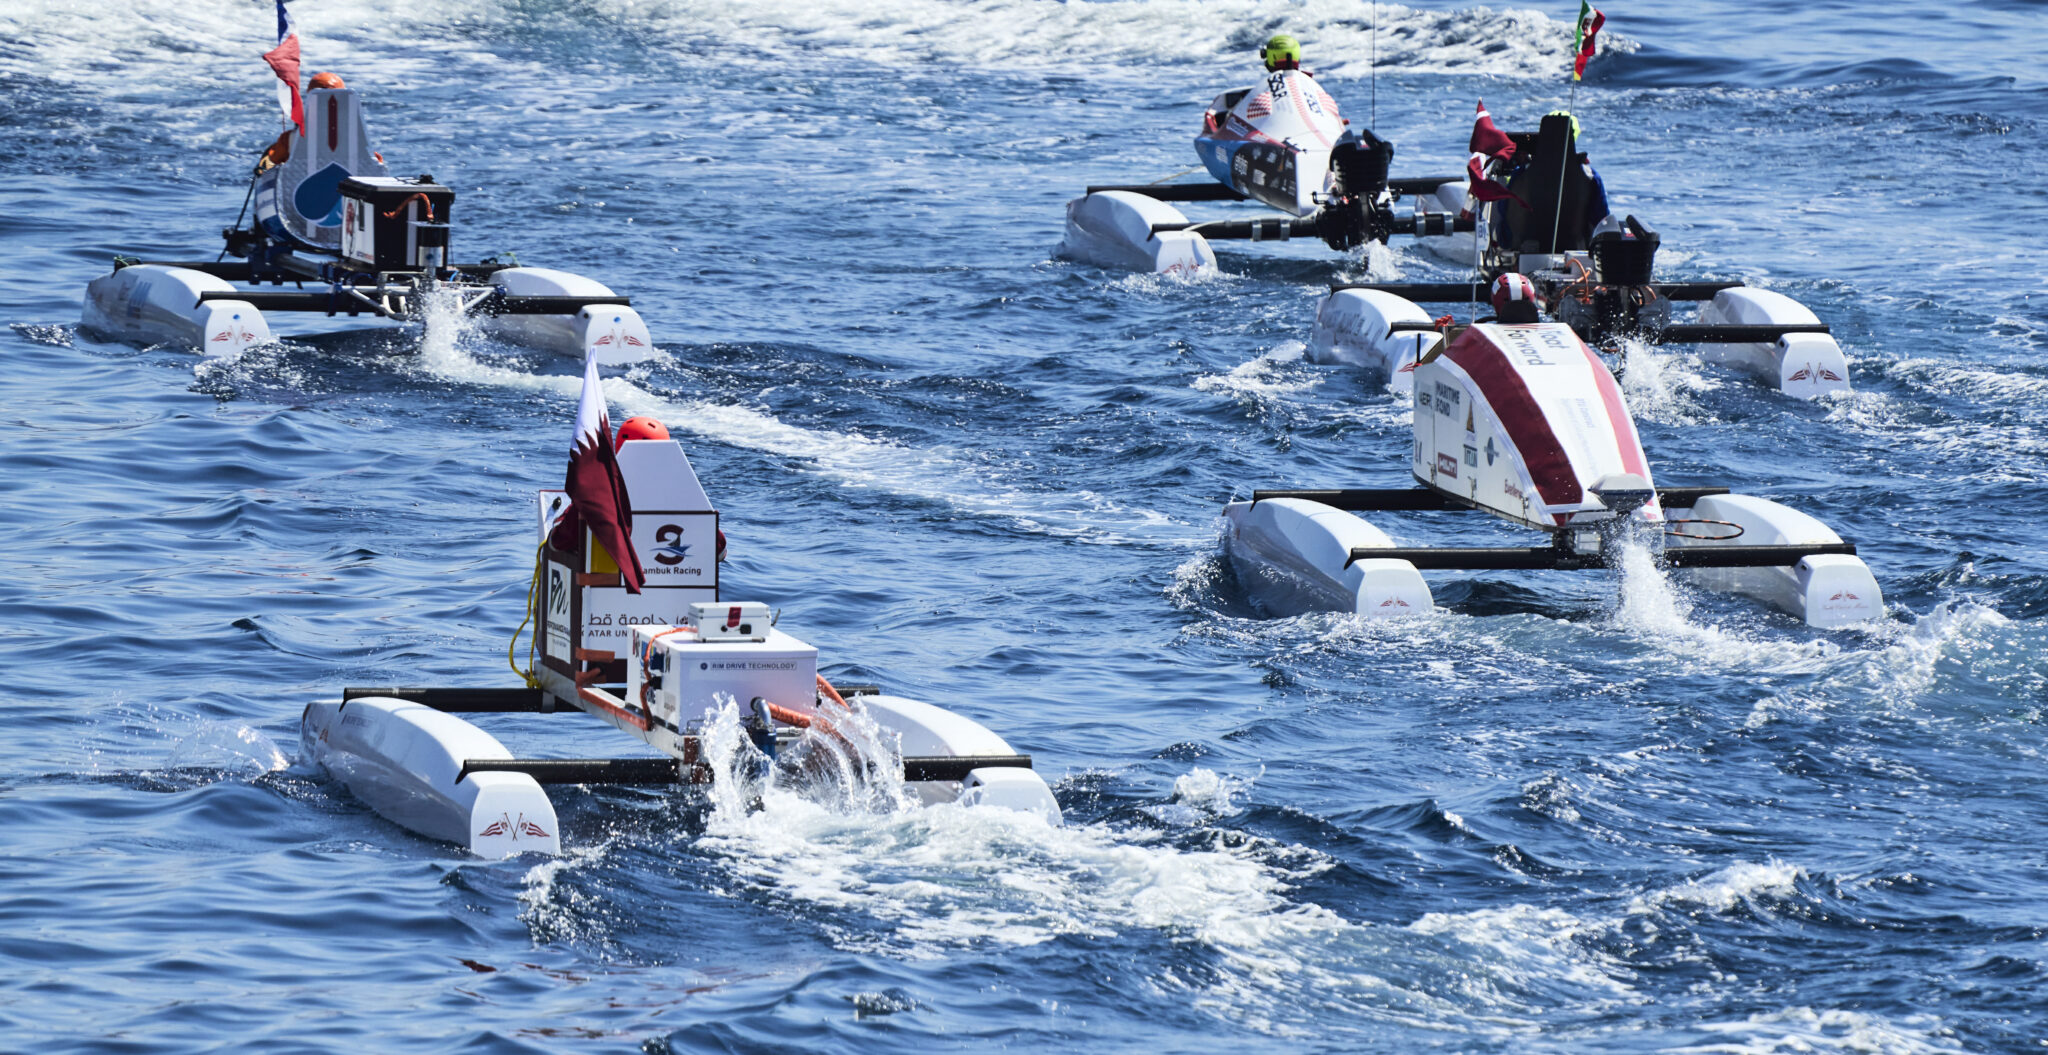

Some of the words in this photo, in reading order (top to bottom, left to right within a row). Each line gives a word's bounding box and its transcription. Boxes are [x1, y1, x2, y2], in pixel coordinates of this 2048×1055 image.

[1504, 329, 1557, 366] Forward
[1435, 381, 1460, 405] MARITIME
[1436, 398, 1450, 417] FOND
[643, 566, 671, 575] ambuk
[673, 566, 701, 577] Racing
